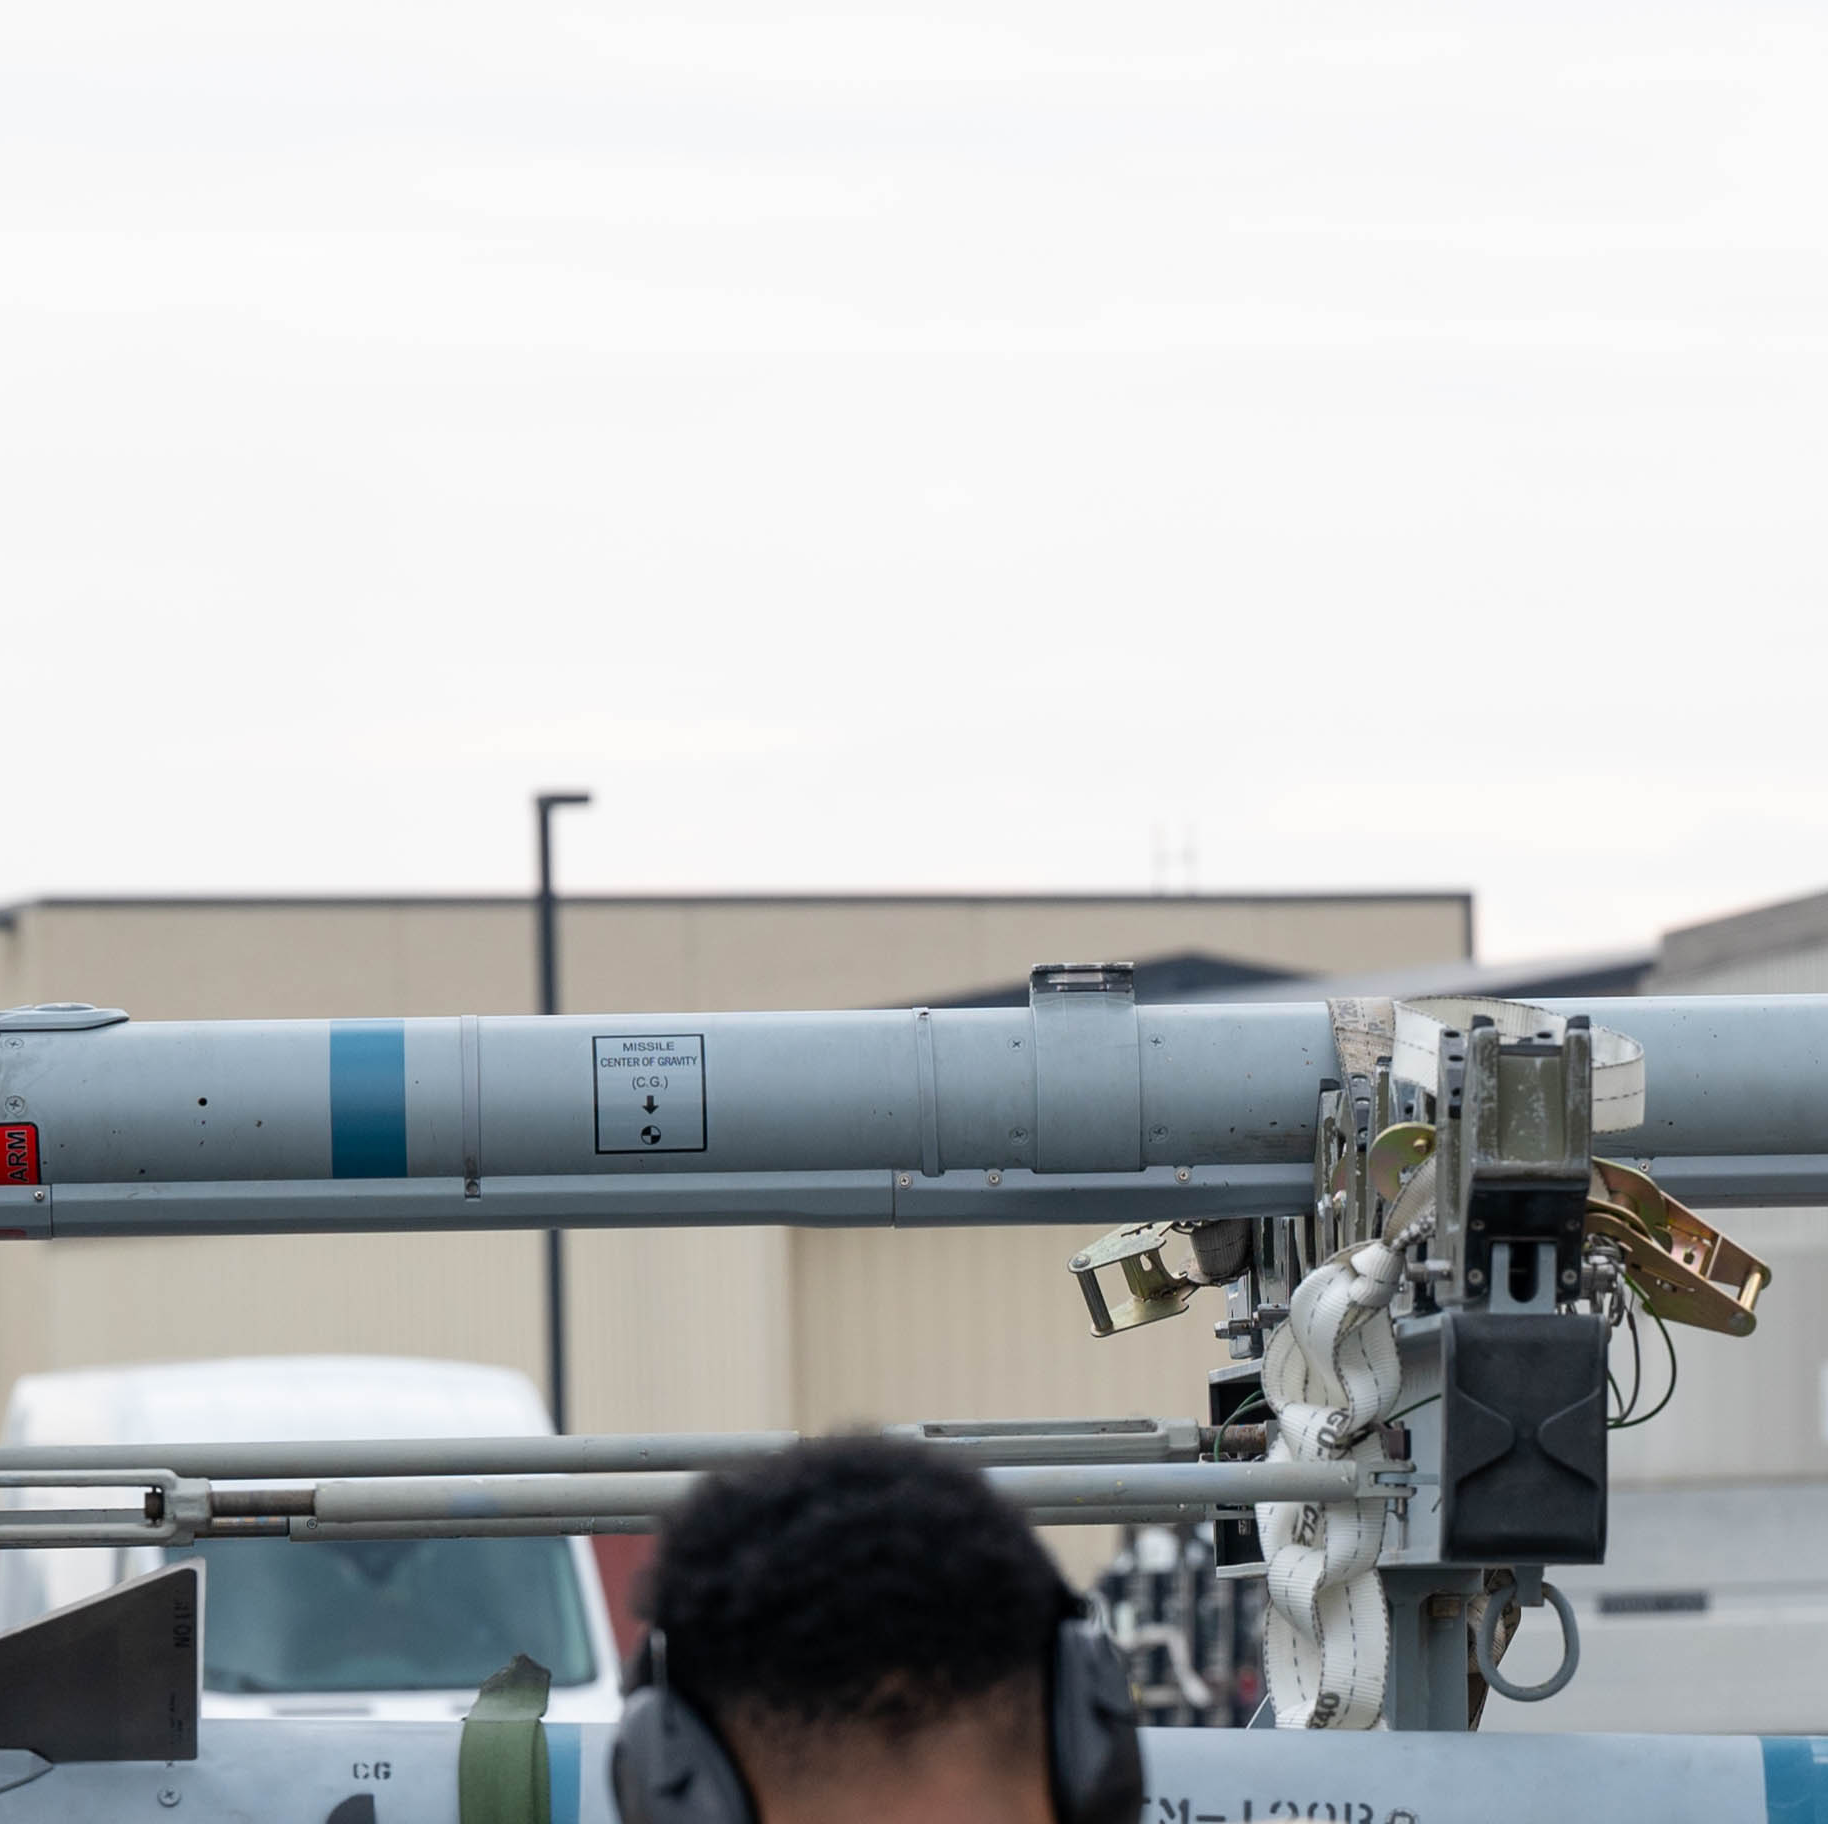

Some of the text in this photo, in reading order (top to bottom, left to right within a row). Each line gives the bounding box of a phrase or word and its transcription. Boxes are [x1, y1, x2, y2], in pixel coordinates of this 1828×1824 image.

[622, 1041, 675, 1052] MISSILE
[600, 1055, 698, 1068] CENTER OF GRAVITY
[5, 1130, 29, 1183] ARM
[352, 1761, 392, 1780] CG
